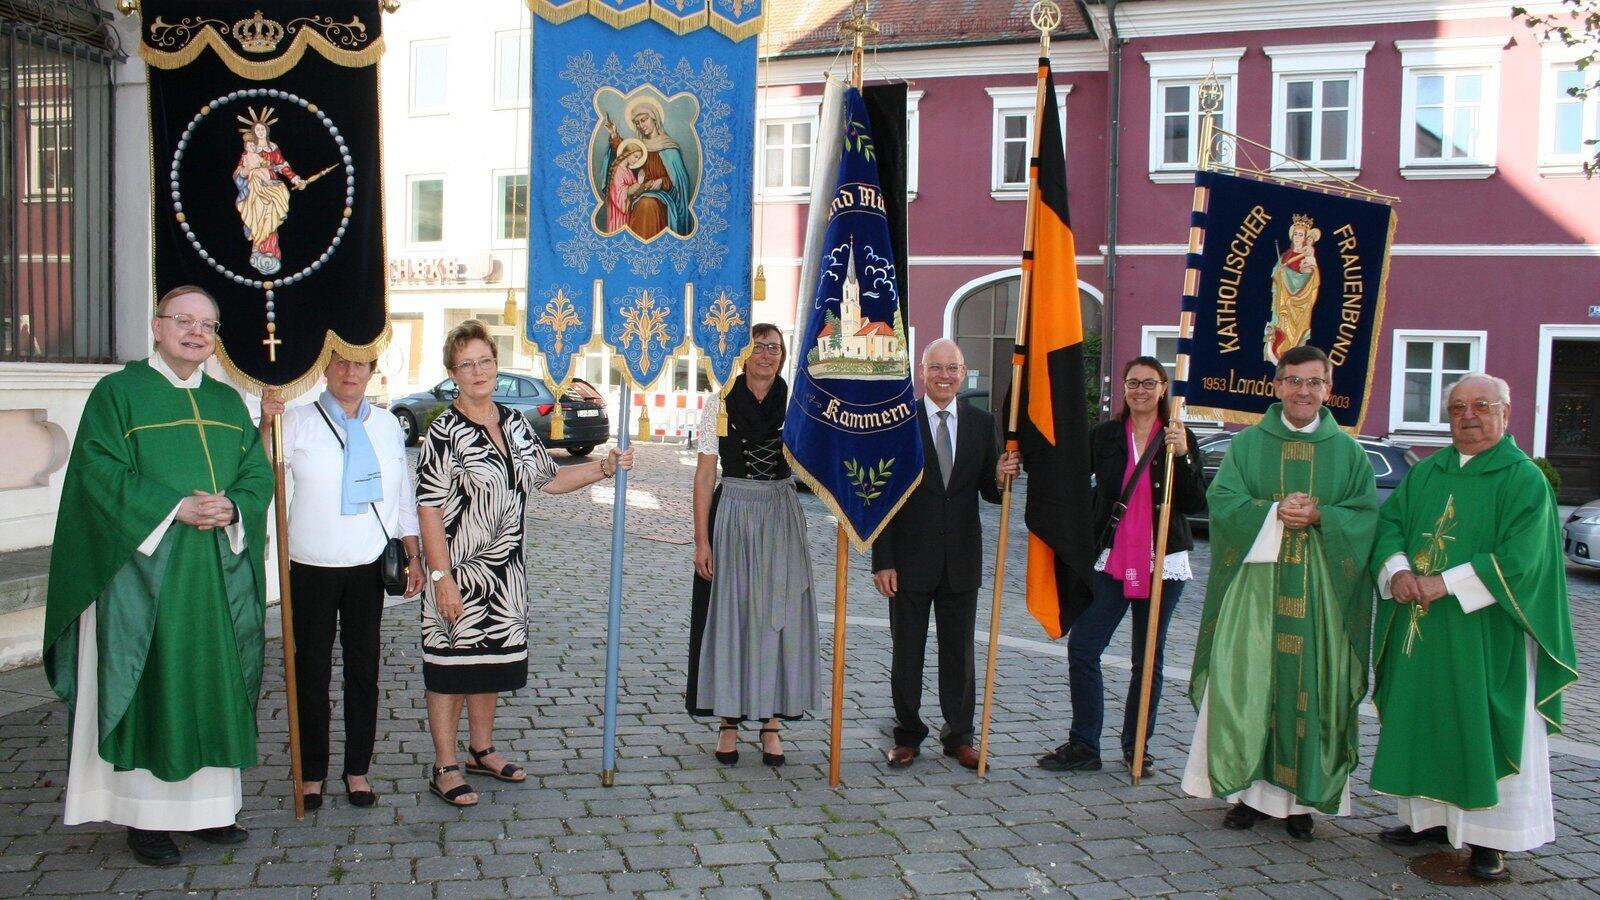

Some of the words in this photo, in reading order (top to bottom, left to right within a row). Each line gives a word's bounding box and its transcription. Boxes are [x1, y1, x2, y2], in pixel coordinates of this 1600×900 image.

[1216, 204, 1272, 354] KATHOLISCHER
[1328, 223, 1365, 367] FRAUENBUND
[1202, 376, 1227, 391] 1953
[1327, 395, 1350, 408] 2003
[822, 398, 911, 429] Kammern
